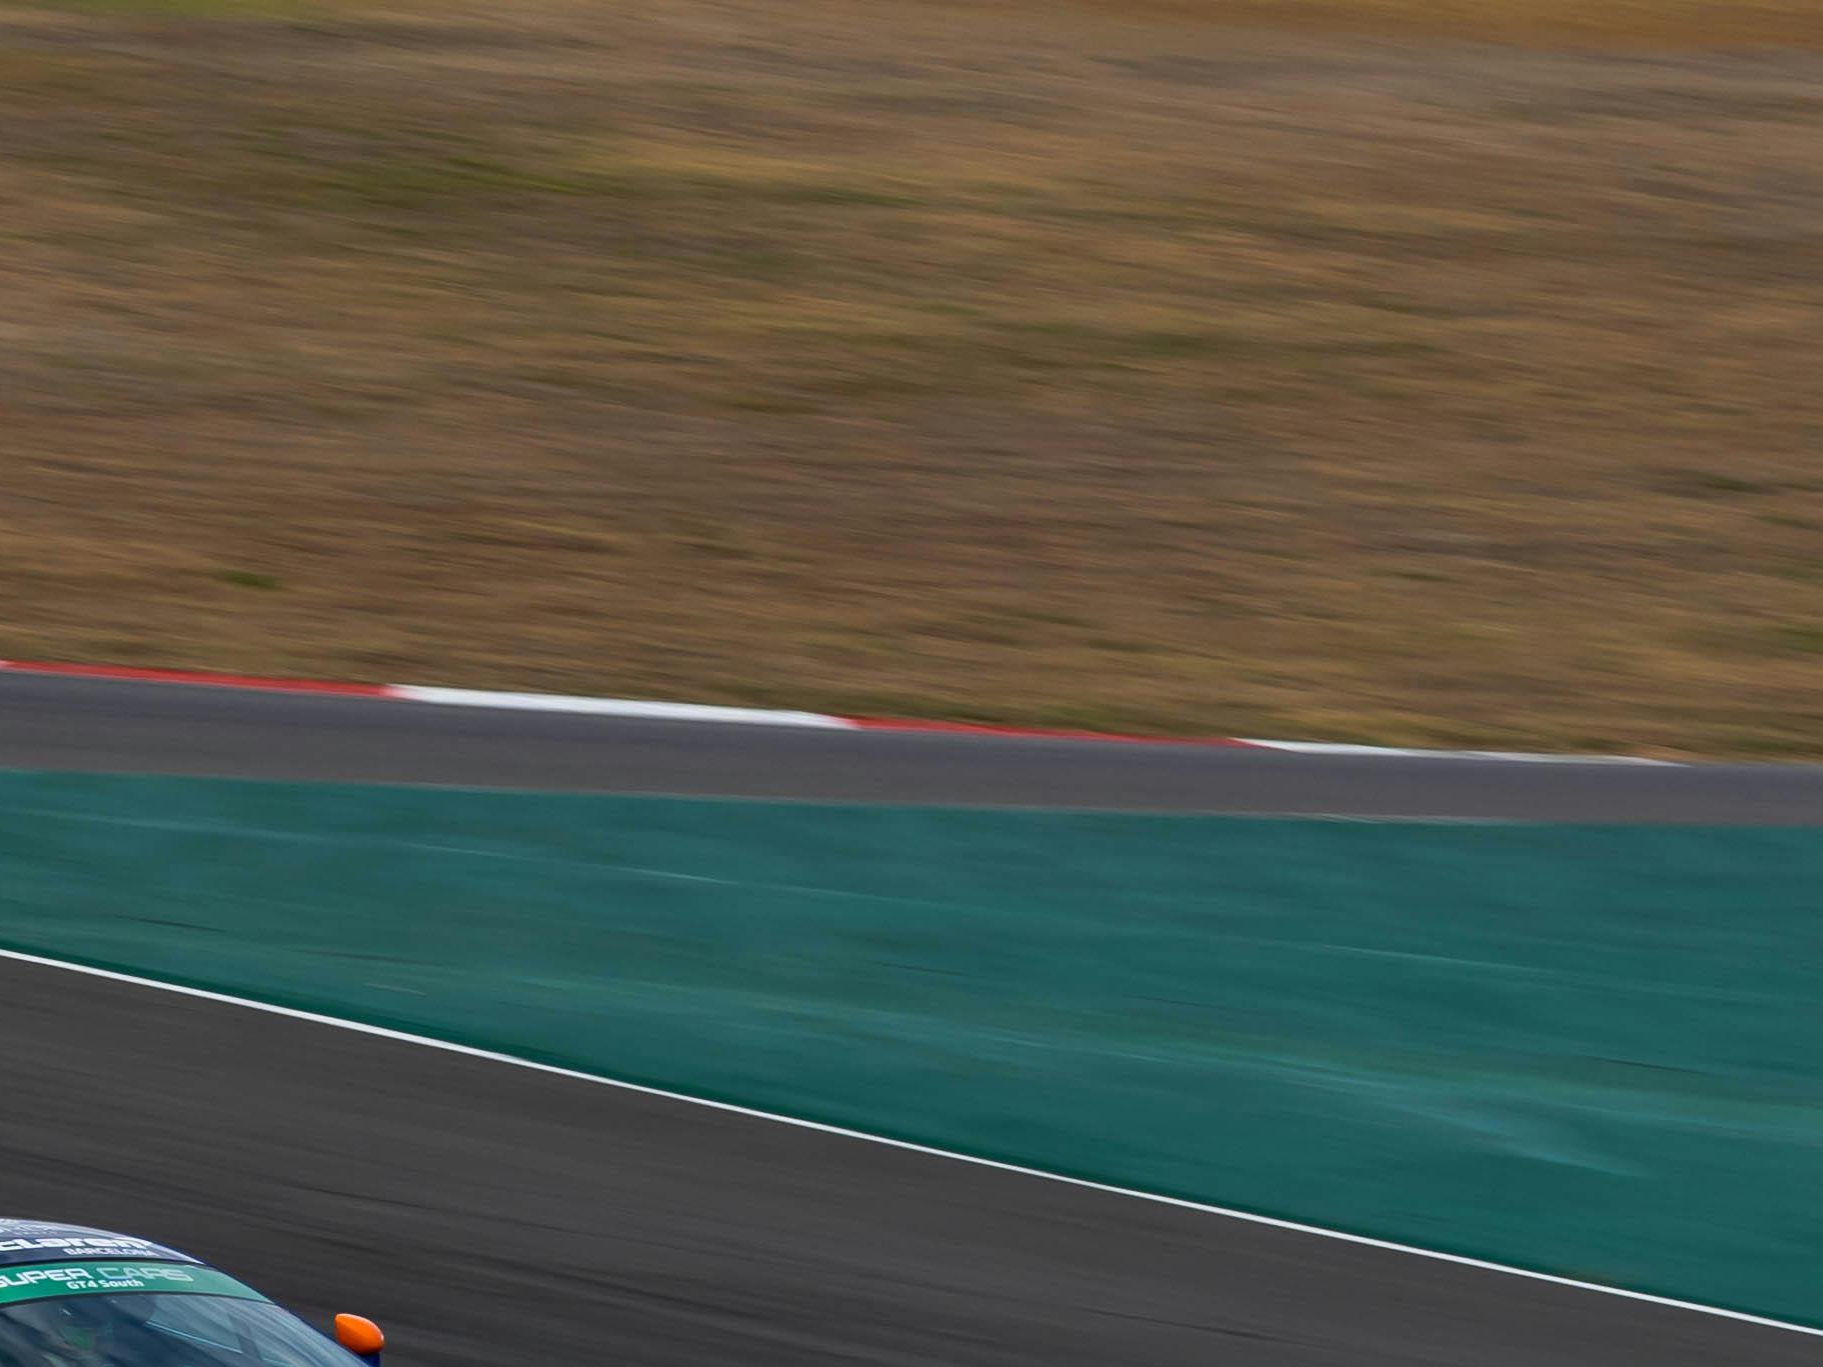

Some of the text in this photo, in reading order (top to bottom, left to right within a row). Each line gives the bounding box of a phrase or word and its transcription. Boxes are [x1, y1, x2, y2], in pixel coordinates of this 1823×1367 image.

[95, 1266, 195, 1283] CARS
[65, 1278, 145, 1290] GT4 South
